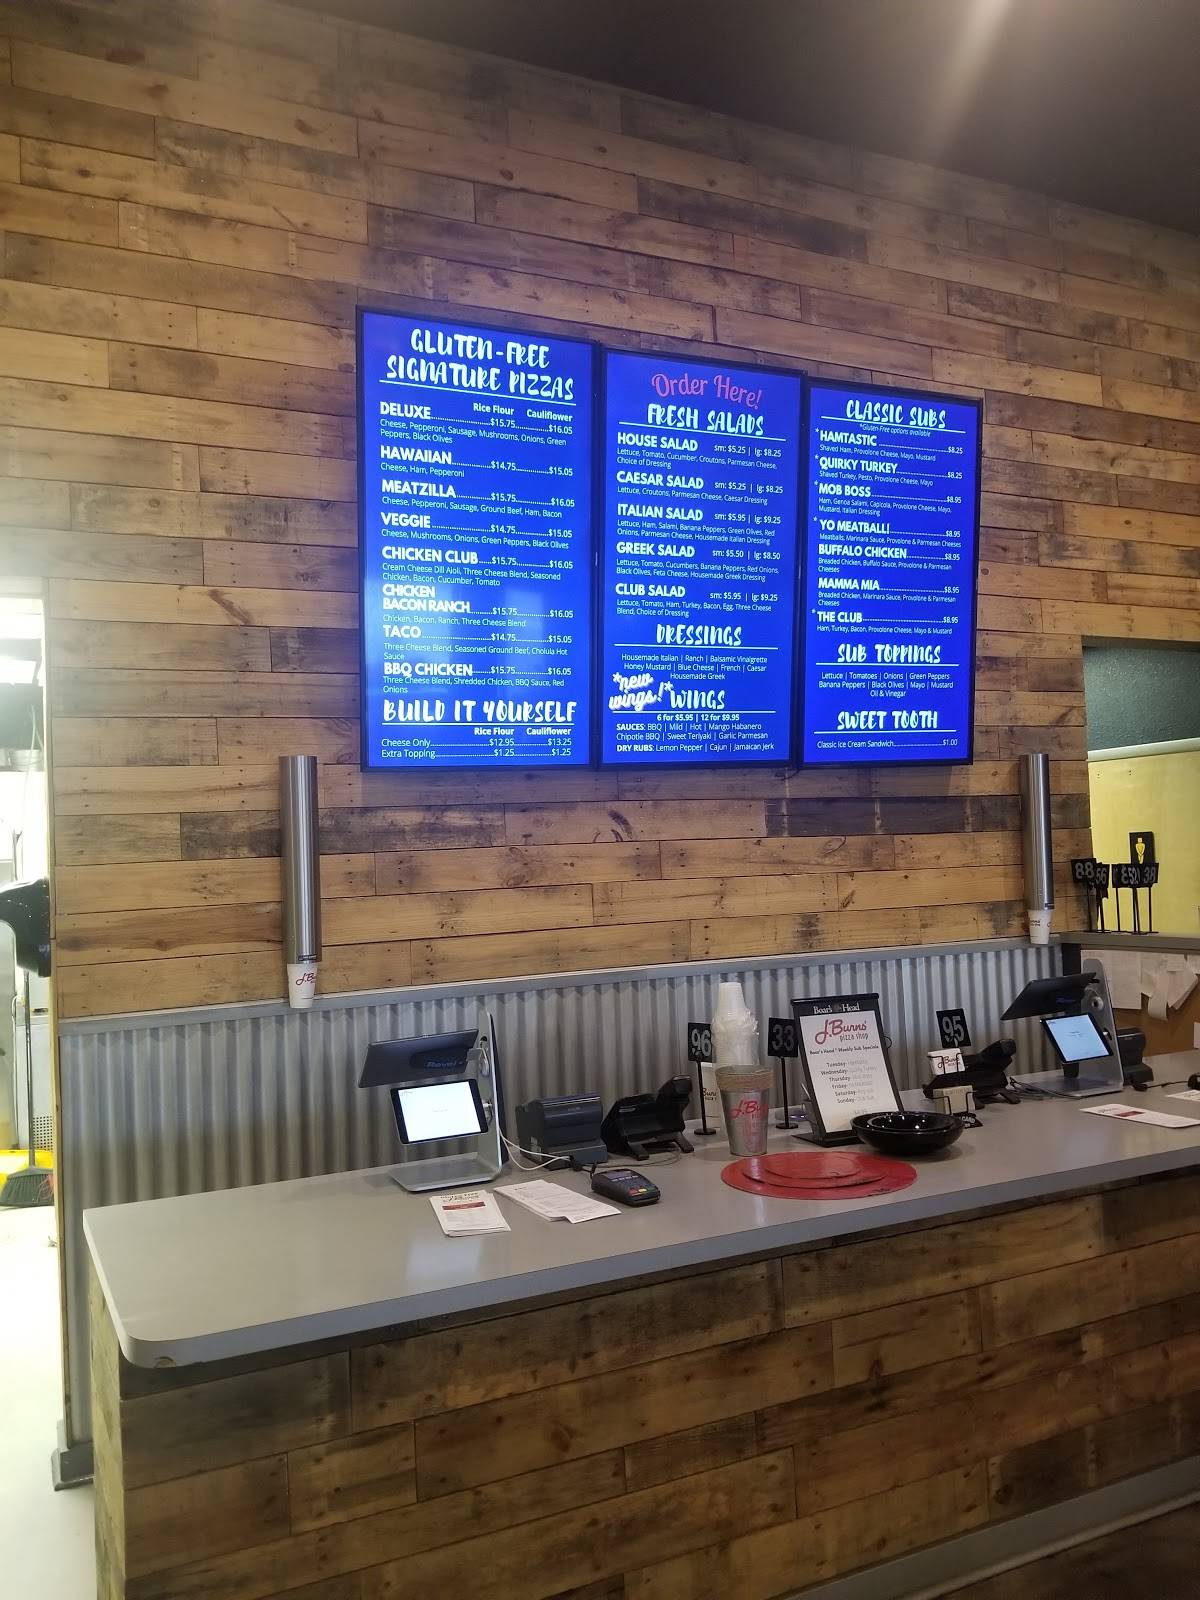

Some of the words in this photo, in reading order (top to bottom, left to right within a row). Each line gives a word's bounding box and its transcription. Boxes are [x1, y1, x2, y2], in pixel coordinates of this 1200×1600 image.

[410, 328, 549, 368] GLUTEN-FREE
[386, 354, 500, 390] SIGNATURE
[509, 370, 573, 400] PIZZAS
[651, 373, 708, 397] Order
[713, 374, 762, 409] Here!
[380, 401, 431, 419] DELUXE
[489, 417, 515, 428] $15.75
[548, 424, 572, 434] $16.05
[647, 403, 698, 429] FRESH
[706, 410, 763, 435] SALADS
[846, 399, 903, 423] CLASSIC
[909, 406, 945, 428] SUBS
[617, 432, 657, 447] HOUSE
[660, 436, 698, 451] SALAD
[727, 444, 745, 453] $5.25
[763, 448, 781, 457] $8.25
[380, 444, 451, 464] HAWAIIAN
[490, 460, 516, 470] $14.75
[548, 466, 573, 476] $15.05
[860, 460, 897, 473] TURKEY
[382, 478, 456, 498] MEATZILLA
[490, 492, 516, 502] $15.75
[550, 497, 574, 507] $16.05
[616, 470, 663, 486] CAESAR
[666, 474, 704, 489] SALAD
[728, 481, 746, 490] $5.25
[765, 485, 783, 493] $8.25
[380, 512, 430, 528] VEGGIE
[490, 524, 515, 534] $14.75
[547, 528, 572, 538] $15.05
[617, 503, 663, 518] ITALIAN
[665, 507, 703, 520] SALAD
[727, 512, 745, 521] $5.95
[763, 515, 780, 524] $9.25
[836, 520, 889, 534] MEATBALL!
[382, 545, 442, 562] CHICKEN
[444, 550, 478, 564] CLUB
[491, 556, 517, 565] $15.75
[549, 559, 573, 569] $16.05
[616, 541, 655, 555] GREEK
[657, 544, 695, 557] SALAD
[725, 549, 744, 557] $5.50
[762, 551, 780, 559] $8.50
[382, 583, 435, 598] CHICKEN
[382, 597, 427, 611] BACON
[428, 599, 470, 613] RANCH
[492, 607, 517, 616] $15.75
[549, 609, 573, 618] $16.05
[382, 624, 421, 638] TACO
[490, 632, 516, 641] $14.75
[548, 634, 572, 643] $15.05
[656, 623, 741, 646] DRESSINGS
[837, 643, 866, 662] SUB
[874, 644, 940, 663] TOPPINGS
[384, 661, 412, 677] BBQ
[414, 662, 473, 676] CHICKEN
[490, 666, 516, 674] $15.75
[547, 667, 571, 675] $16.05
[383, 699, 445, 722] BUILD
[454, 700, 476, 721] IT
[482, 699, 576, 722] YOURSELF
[670, 689, 724, 709] WINGS
[837, 710, 887, 730] SWEET
[891, 710, 937, 728] TOOTH
[488, 738, 514, 746] $12.95
[547, 737, 571, 746] $13.25
[494, 748, 514, 756] $1.25
[551, 748, 571, 756] $1.25
[772, 1024, 794, 1050] 33
[942, 1016, 964, 1042] 95
[691, 1028, 711, 1056] 96
